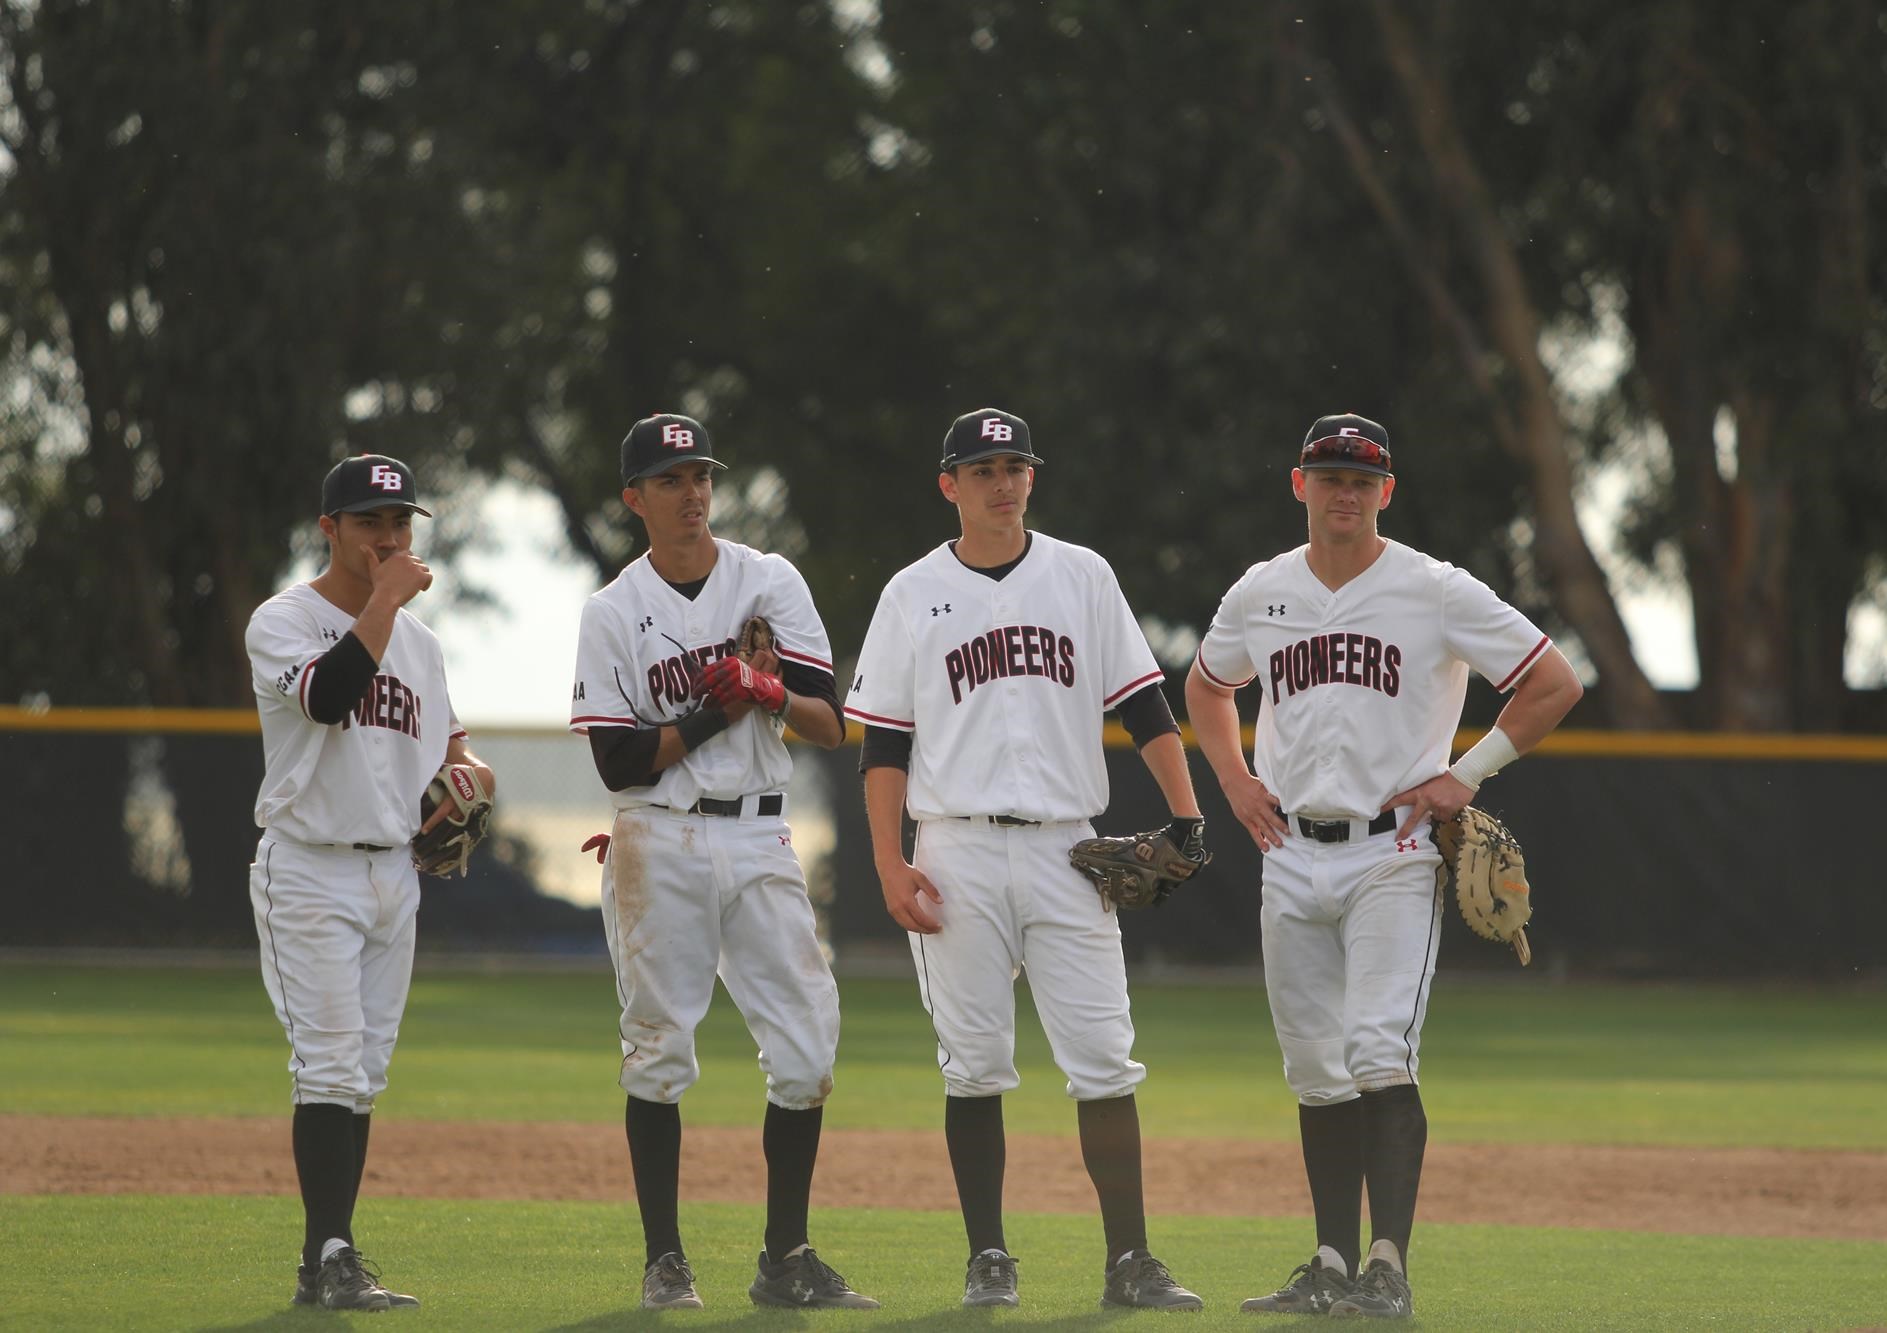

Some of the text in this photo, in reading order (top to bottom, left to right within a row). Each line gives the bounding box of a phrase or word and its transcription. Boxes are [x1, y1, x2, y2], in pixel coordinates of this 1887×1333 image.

[662, 424, 694, 449] EB
[981, 417, 1013, 442] EB
[370, 465, 402, 491] EB
[944, 624, 1076, 706] PIONEERS
[1269, 632, 1402, 705] PIONEERS
[454, 769, 474, 799] Wilson
